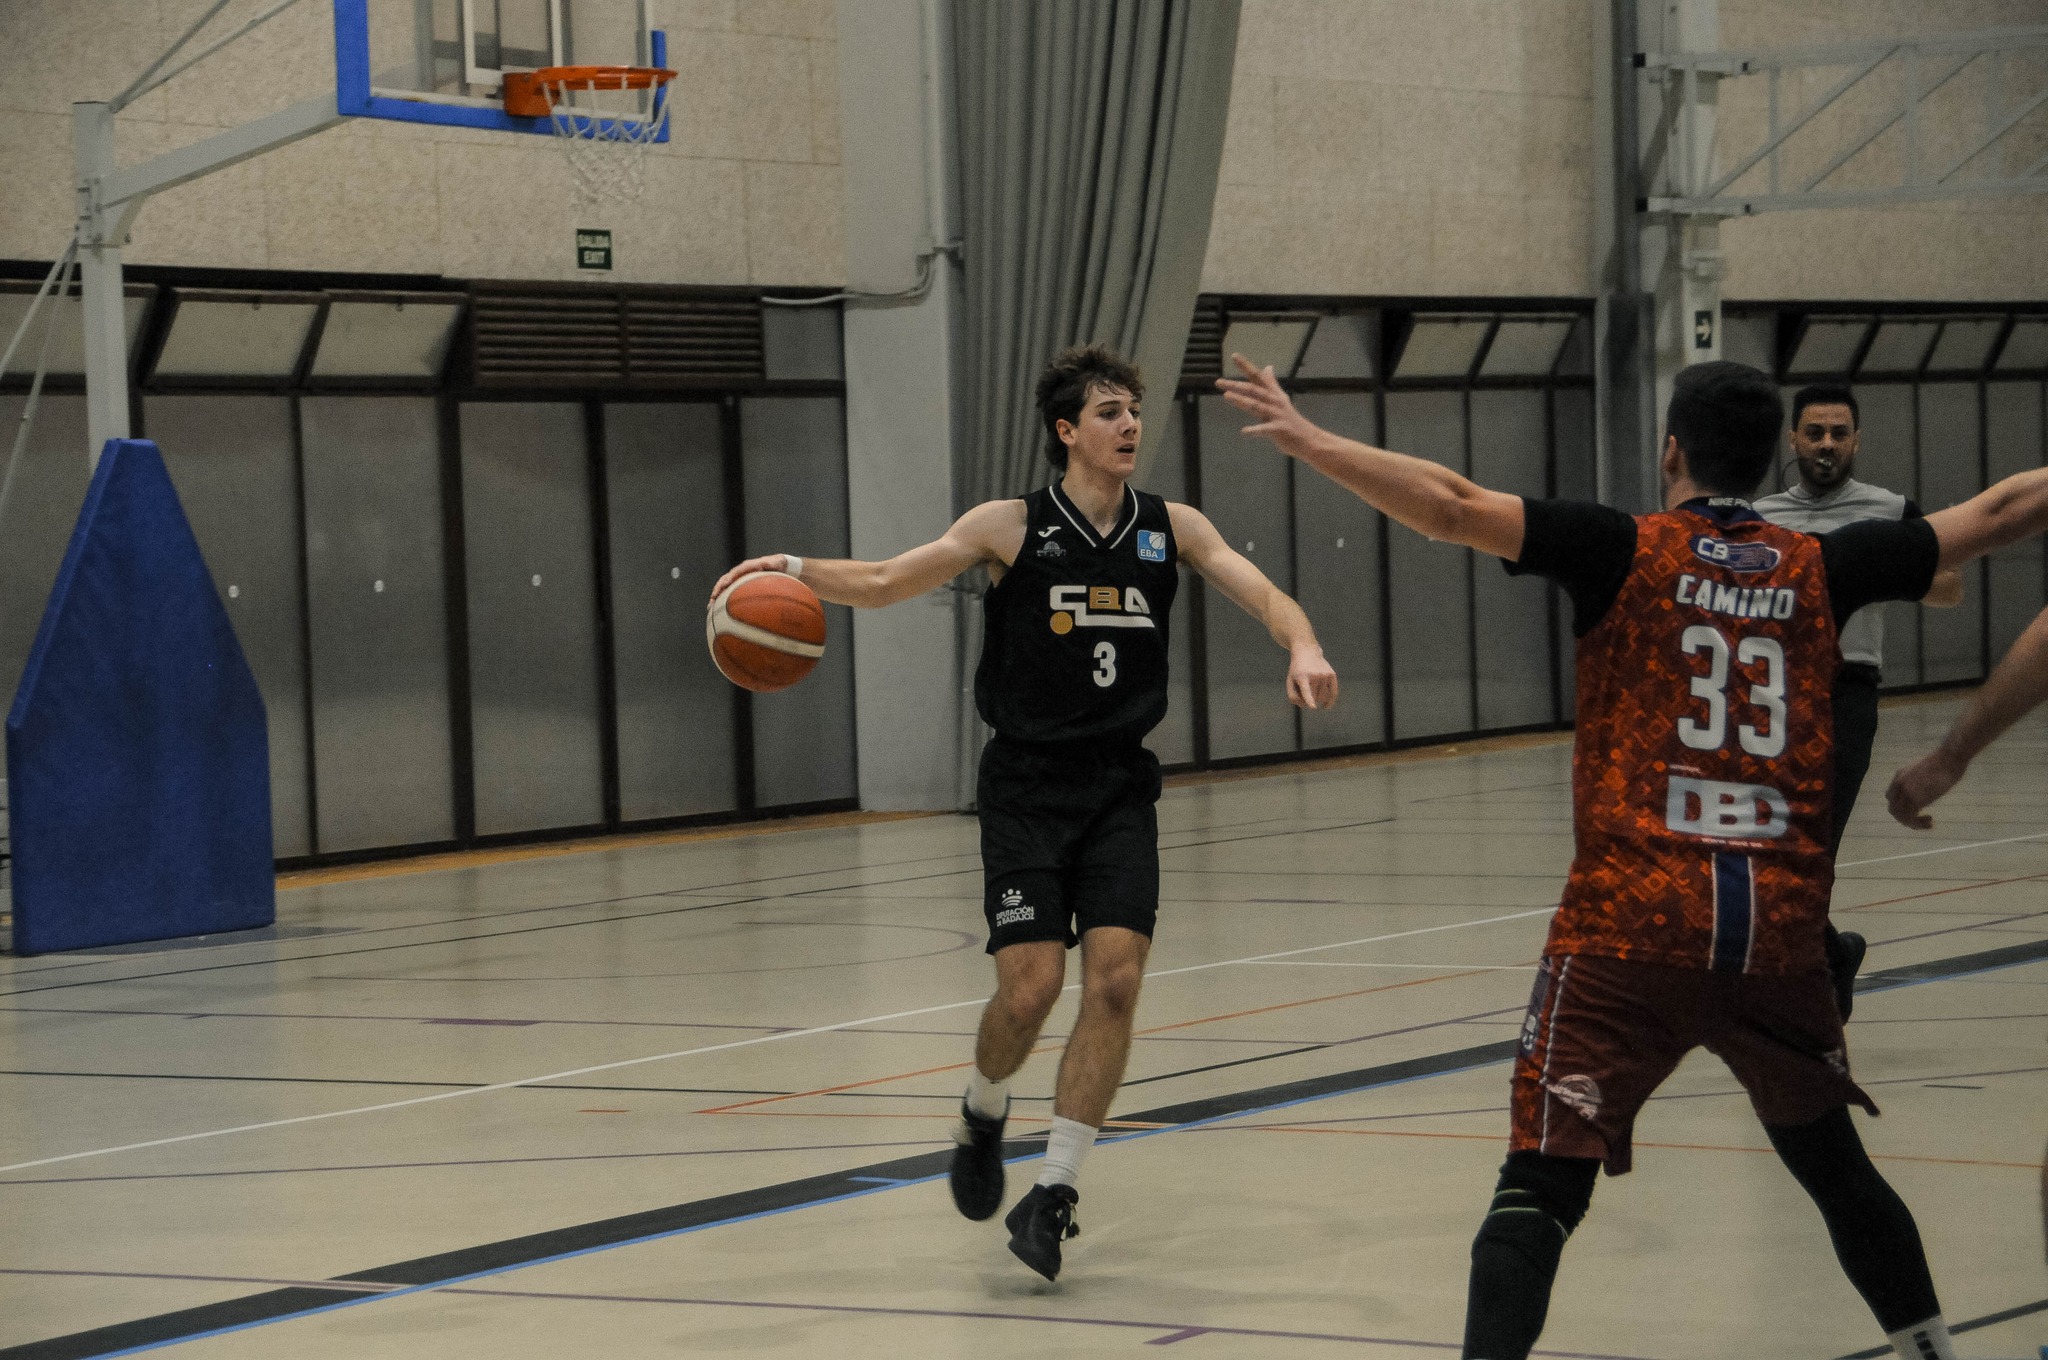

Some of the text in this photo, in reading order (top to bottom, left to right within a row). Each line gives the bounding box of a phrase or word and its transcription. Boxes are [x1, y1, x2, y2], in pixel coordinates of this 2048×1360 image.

[1708, 498, 1733, 506] NIKE
[1140, 549, 1158, 559] EBA
[1676, 574, 1795, 619] CAMINO
[1093, 641, 1116, 687] 3
[1677, 625, 1787, 757] 33
